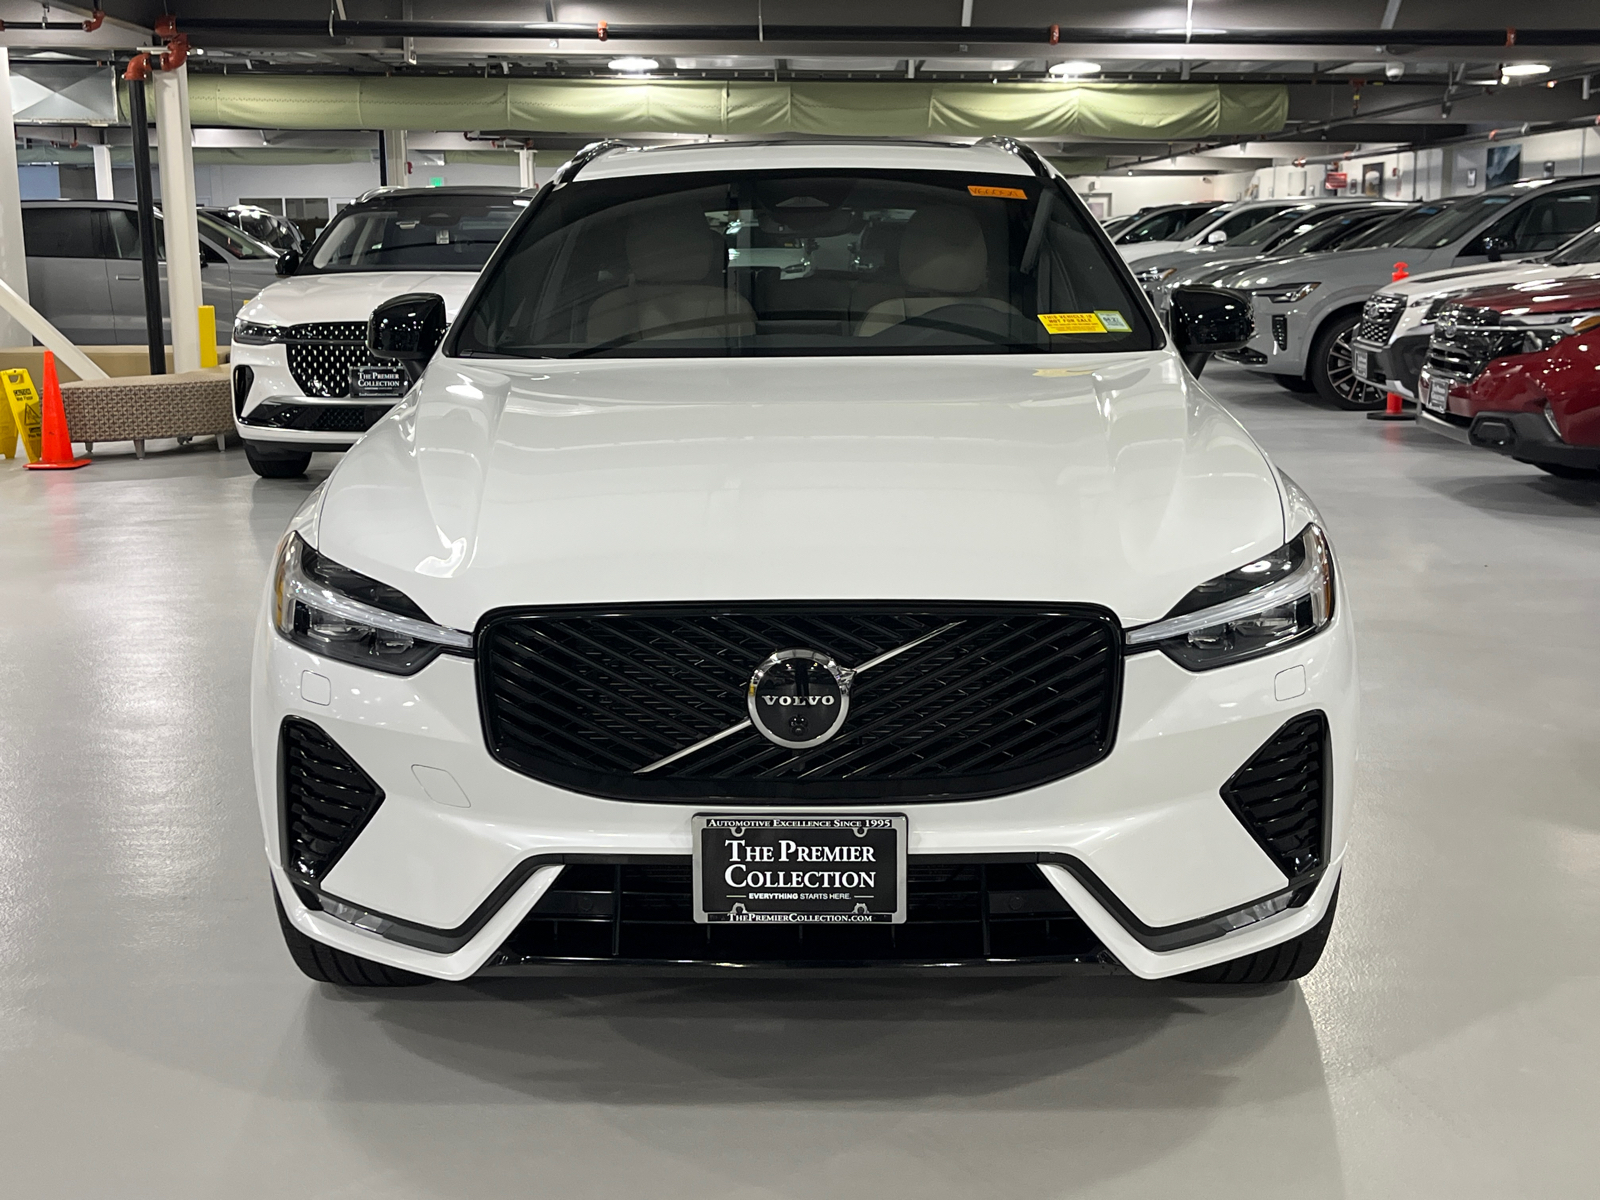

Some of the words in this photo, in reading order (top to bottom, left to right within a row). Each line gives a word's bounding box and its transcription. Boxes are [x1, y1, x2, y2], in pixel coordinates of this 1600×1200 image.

[372, 371, 400, 379] PREMIER
[357, 379, 400, 387] COLLECTION
[761, 695, 835, 706] VOLVO
[708, 819, 771, 827] AUTOMOTIVE
[773, 819, 832, 827] EXCELLENCE
[833, 819, 862, 827] SINCE
[865, 819, 891, 828] 1995
[724, 839, 774, 862] THE
[778, 839, 877, 862] PREMIER
[724, 864, 877, 888] COLLECTION
